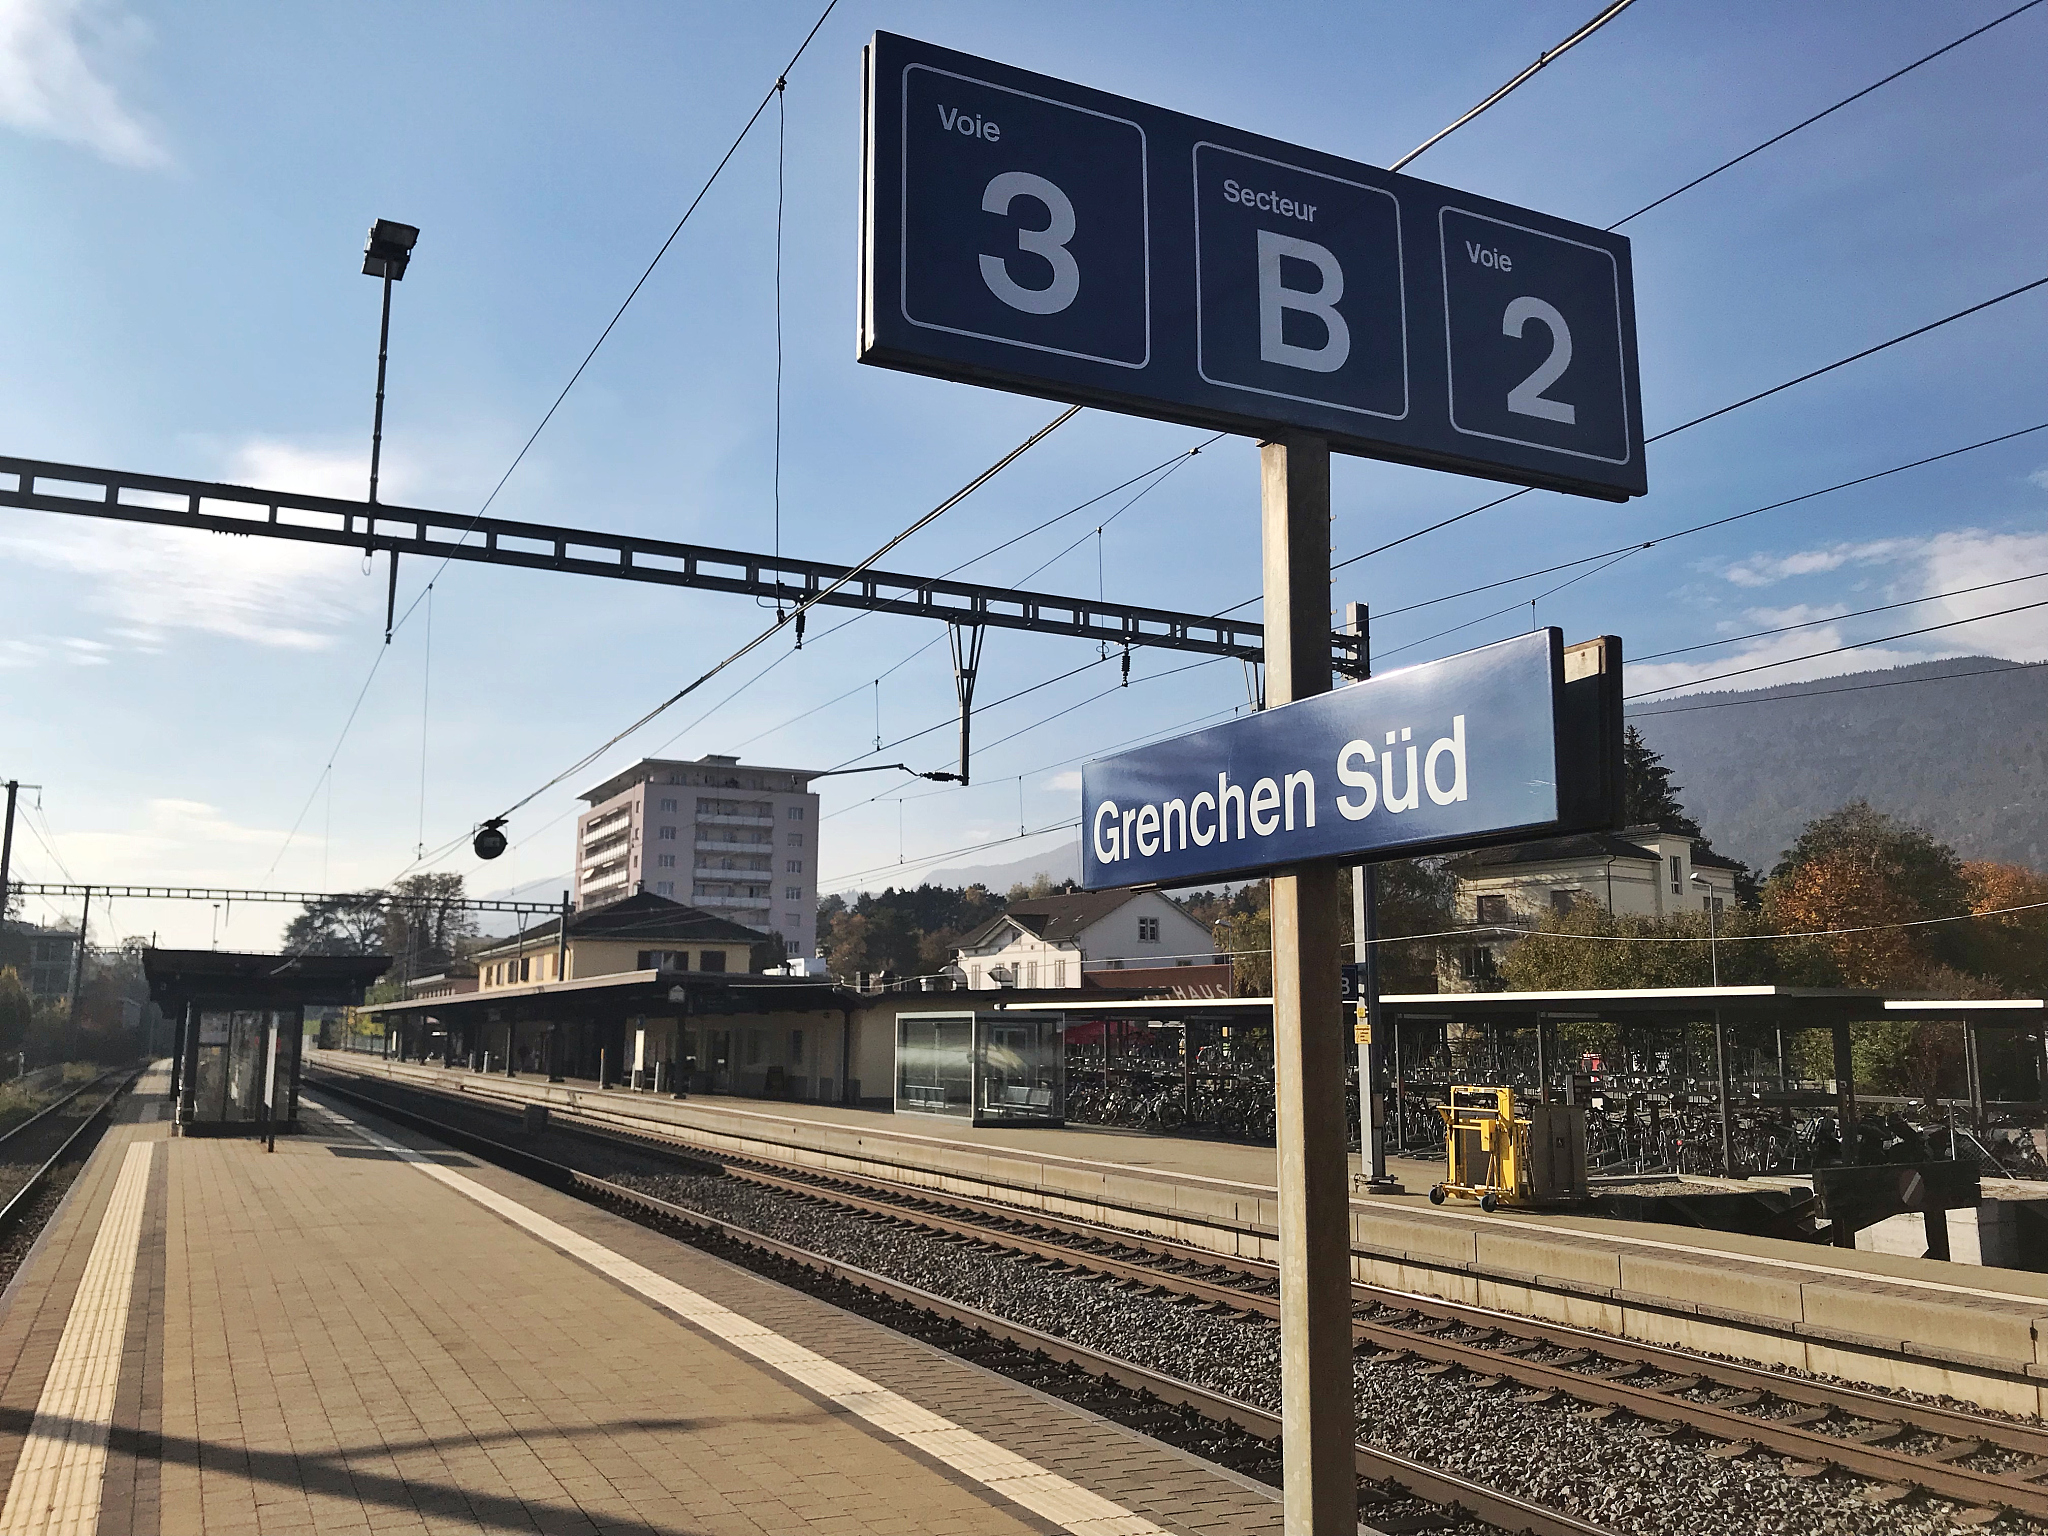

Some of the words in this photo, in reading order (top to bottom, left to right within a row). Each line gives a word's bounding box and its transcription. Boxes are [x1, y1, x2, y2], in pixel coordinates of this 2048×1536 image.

[937, 104, 1001, 142] Voie
[979, 172, 1080, 315] 3
[1223, 179, 1317, 222] Secteur
[1466, 240, 1512, 272] Voie
[1257, 229, 1351, 373] B
[1502, 296, 1576, 425] 2
[1094, 772, 1315, 864] Grenchen
[1336, 715, 1468, 821] Süd
